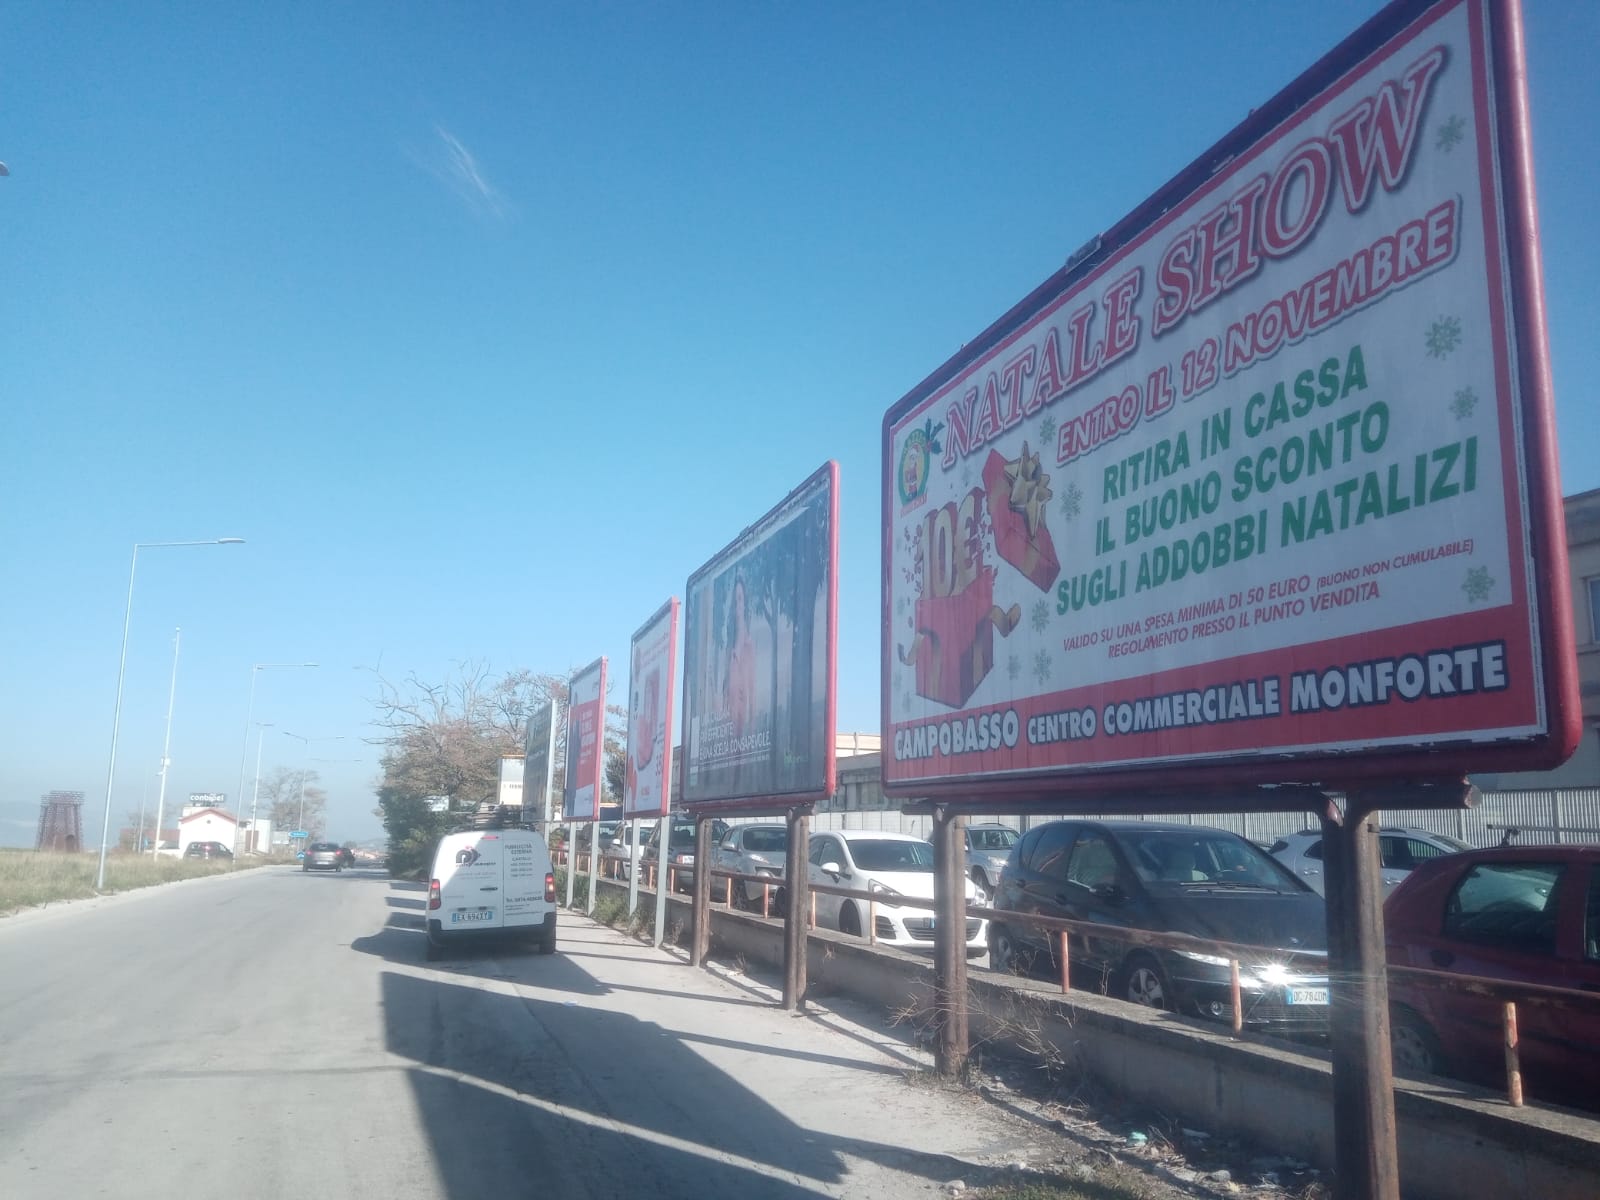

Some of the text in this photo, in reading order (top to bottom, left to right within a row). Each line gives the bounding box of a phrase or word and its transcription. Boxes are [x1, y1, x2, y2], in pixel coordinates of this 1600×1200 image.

[942, 44, 1448, 470] NATALE SHOW
[1056, 199, 1456, 464] ENTRO IL 12 NOVEMBRE
[1095, 400, 1390, 556] IL BUONO SCONTO
[1103, 345, 1368, 504] RITIRA IN CASSA
[1056, 435, 1478, 616] SUGLI ADDOBBI NATALIZI
[1316, 538, 1475, 591] (BUONO NON CUMULABILE)
[1063, 575, 1311, 652] VALIDO SU UNA SPESA MINIMA DI 50 EURO
[1108, 580, 1381, 659] REGOLAMENTO PRESSO IL PUNTO VENDITA
[893, 643, 1507, 762] CAMPOBASSO CENTRO COMMERCIALE MONFORTE
